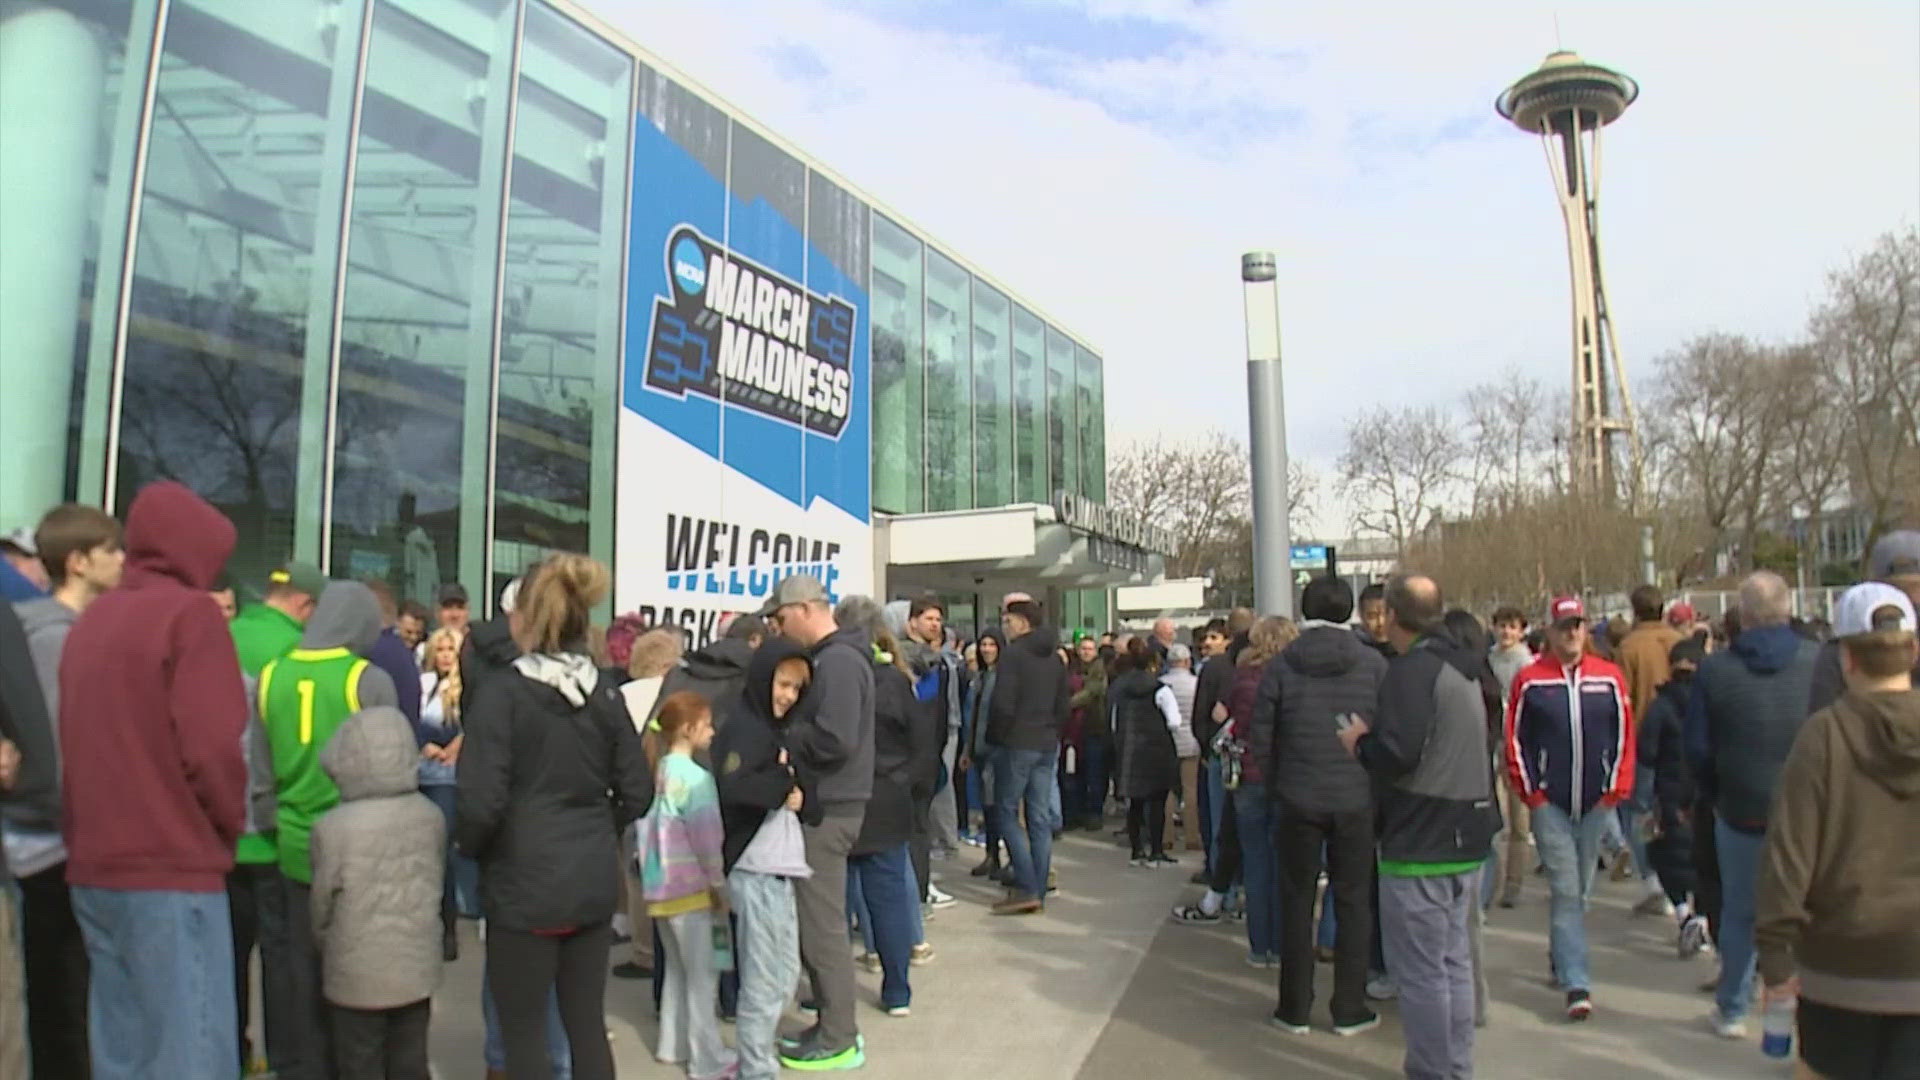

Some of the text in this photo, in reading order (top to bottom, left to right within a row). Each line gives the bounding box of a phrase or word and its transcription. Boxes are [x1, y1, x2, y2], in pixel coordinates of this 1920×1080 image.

[704, 253, 810, 350] MARCH
[716, 319, 849, 418] MADNESS
[666, 512, 841, 605] WELCOME
[297, 679, 315, 744] 1
